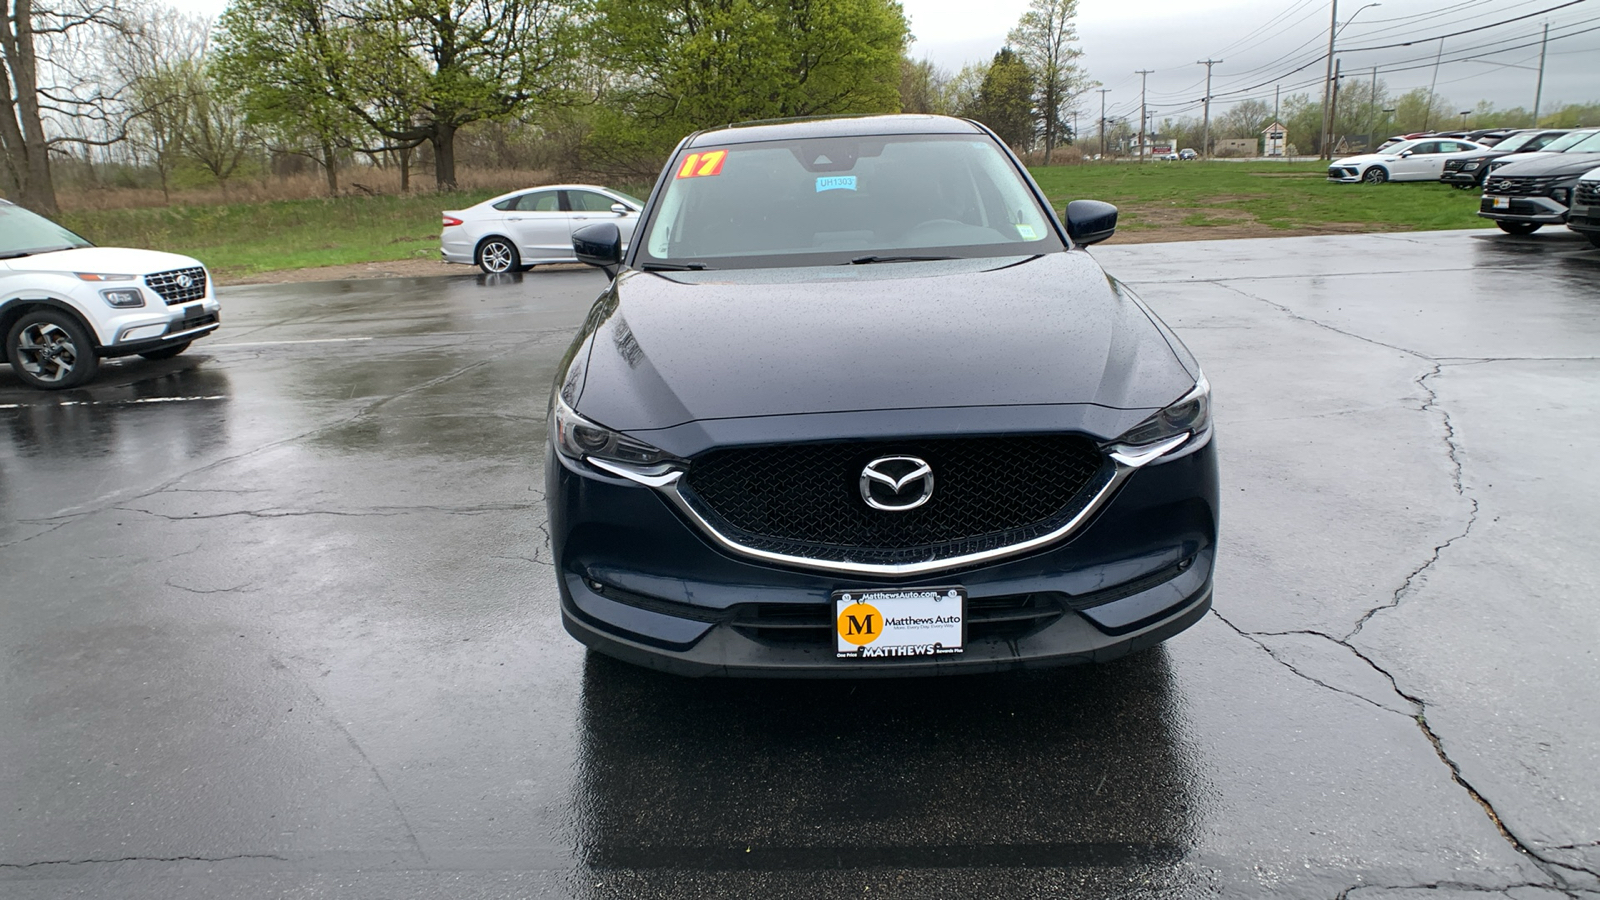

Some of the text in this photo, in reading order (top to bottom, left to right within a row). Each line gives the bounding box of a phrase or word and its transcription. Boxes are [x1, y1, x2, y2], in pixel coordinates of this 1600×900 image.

[679, 150, 725, 177] 17
[820, 178, 853, 187] UH1303
[862, 591, 938, 600] MatthewsAuto.com
[845, 614, 876, 635] M
[885, 615, 961, 626] Matthews Auto
[862, 645, 935, 658] MATTHEWS
